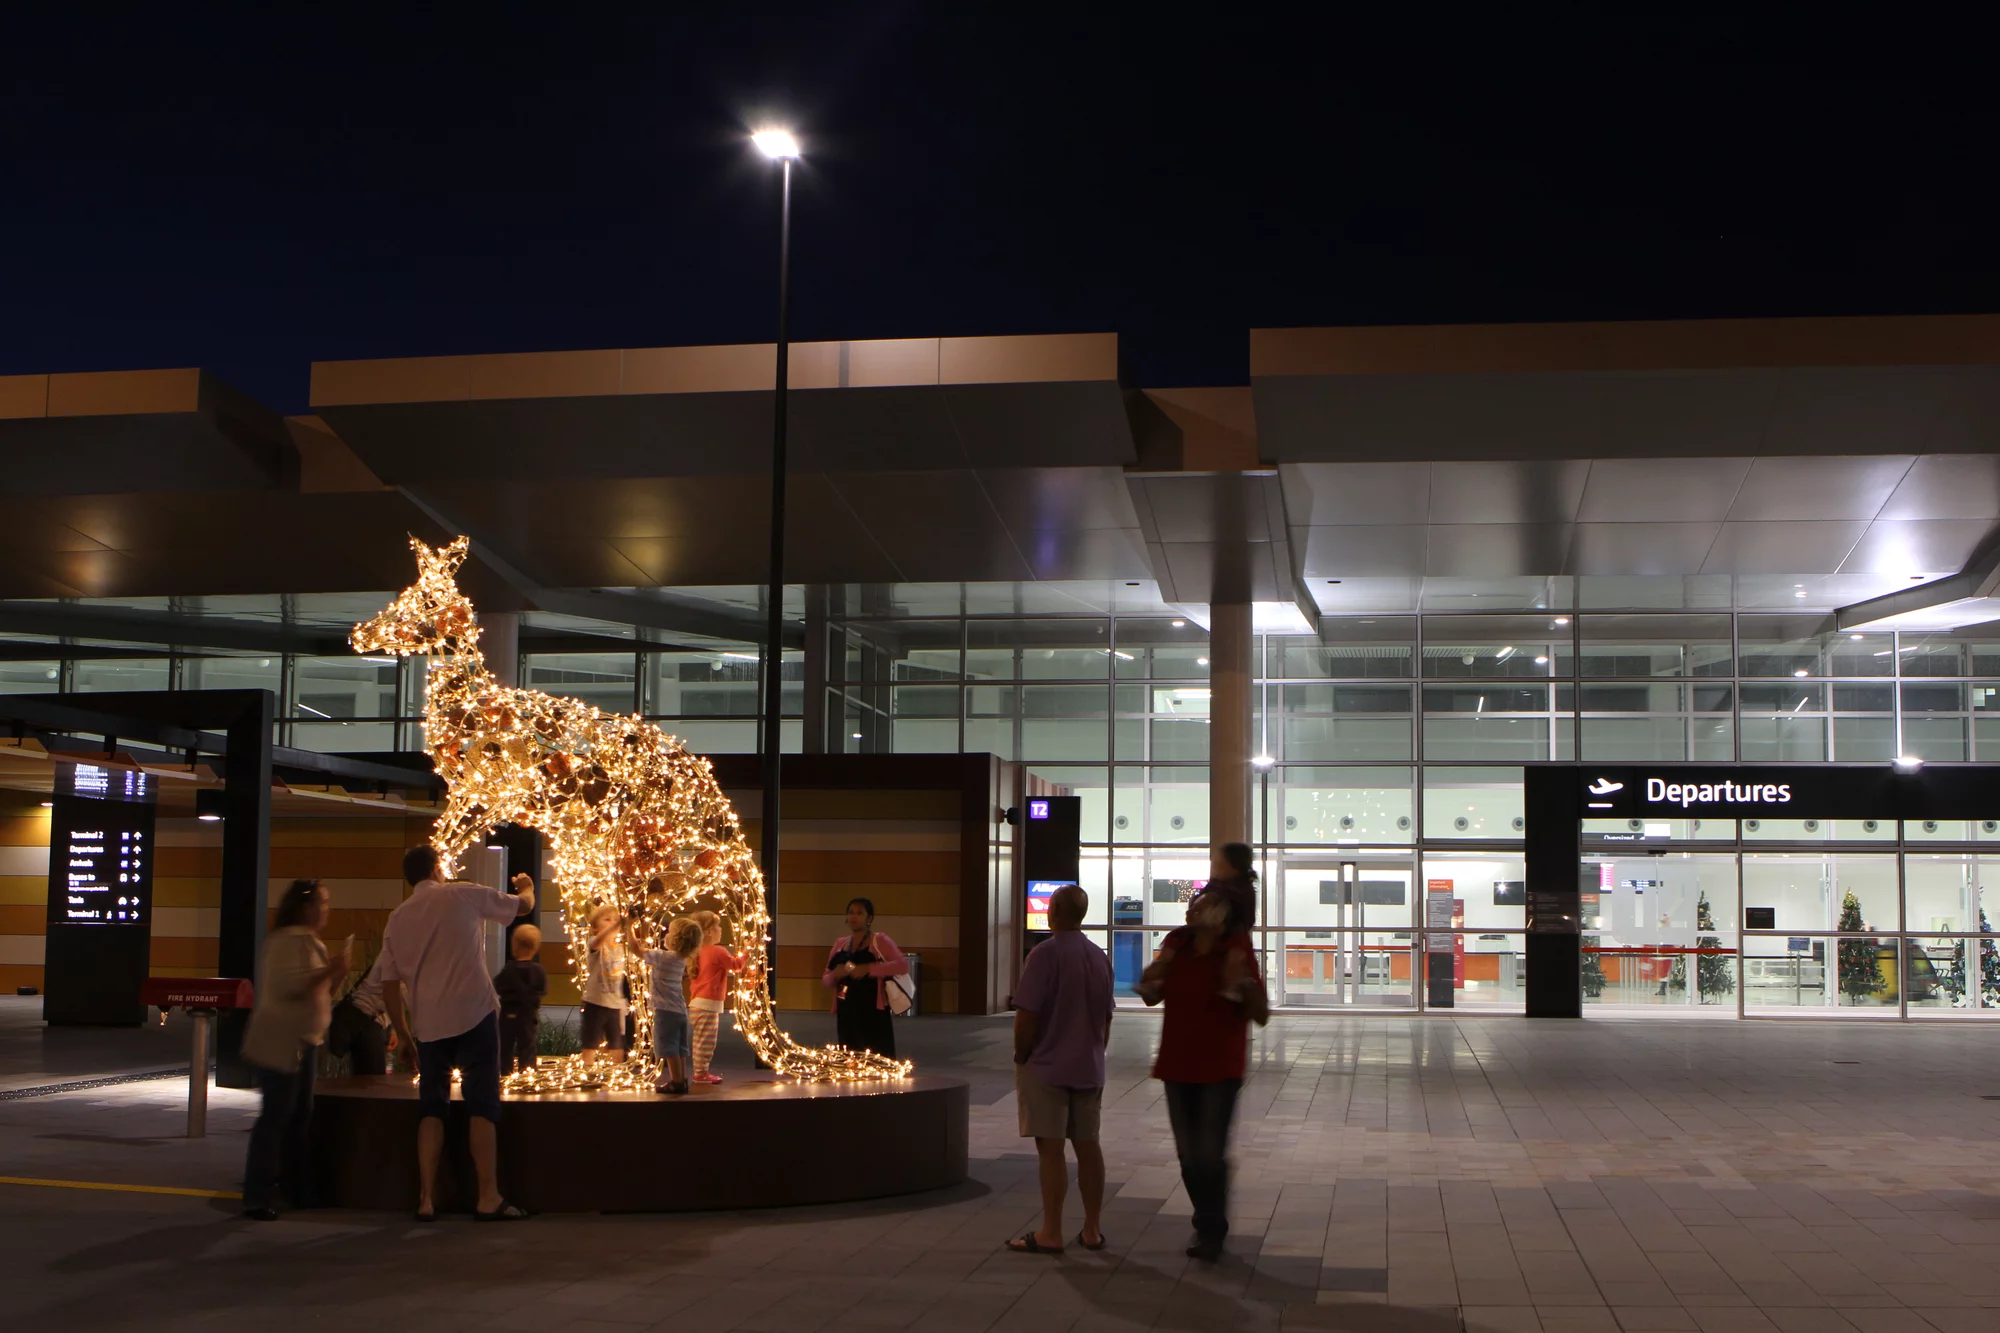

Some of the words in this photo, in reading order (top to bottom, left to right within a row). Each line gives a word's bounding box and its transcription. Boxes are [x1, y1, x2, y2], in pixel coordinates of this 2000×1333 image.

[1647, 778, 1791, 808] Departures
[1031, 803, 1047, 816] T2
[71, 831, 98, 839] Terminal
[99, 831, 103, 839] 2
[69, 845, 104, 854] Departures
[69, 859, 94, 867] Arrivals
[67, 910, 95, 918] Terminal
[95, 910, 100, 918] 1
[167, 994, 184, 1002] FIRE
[185, 995, 219, 1003] HYDRANT
